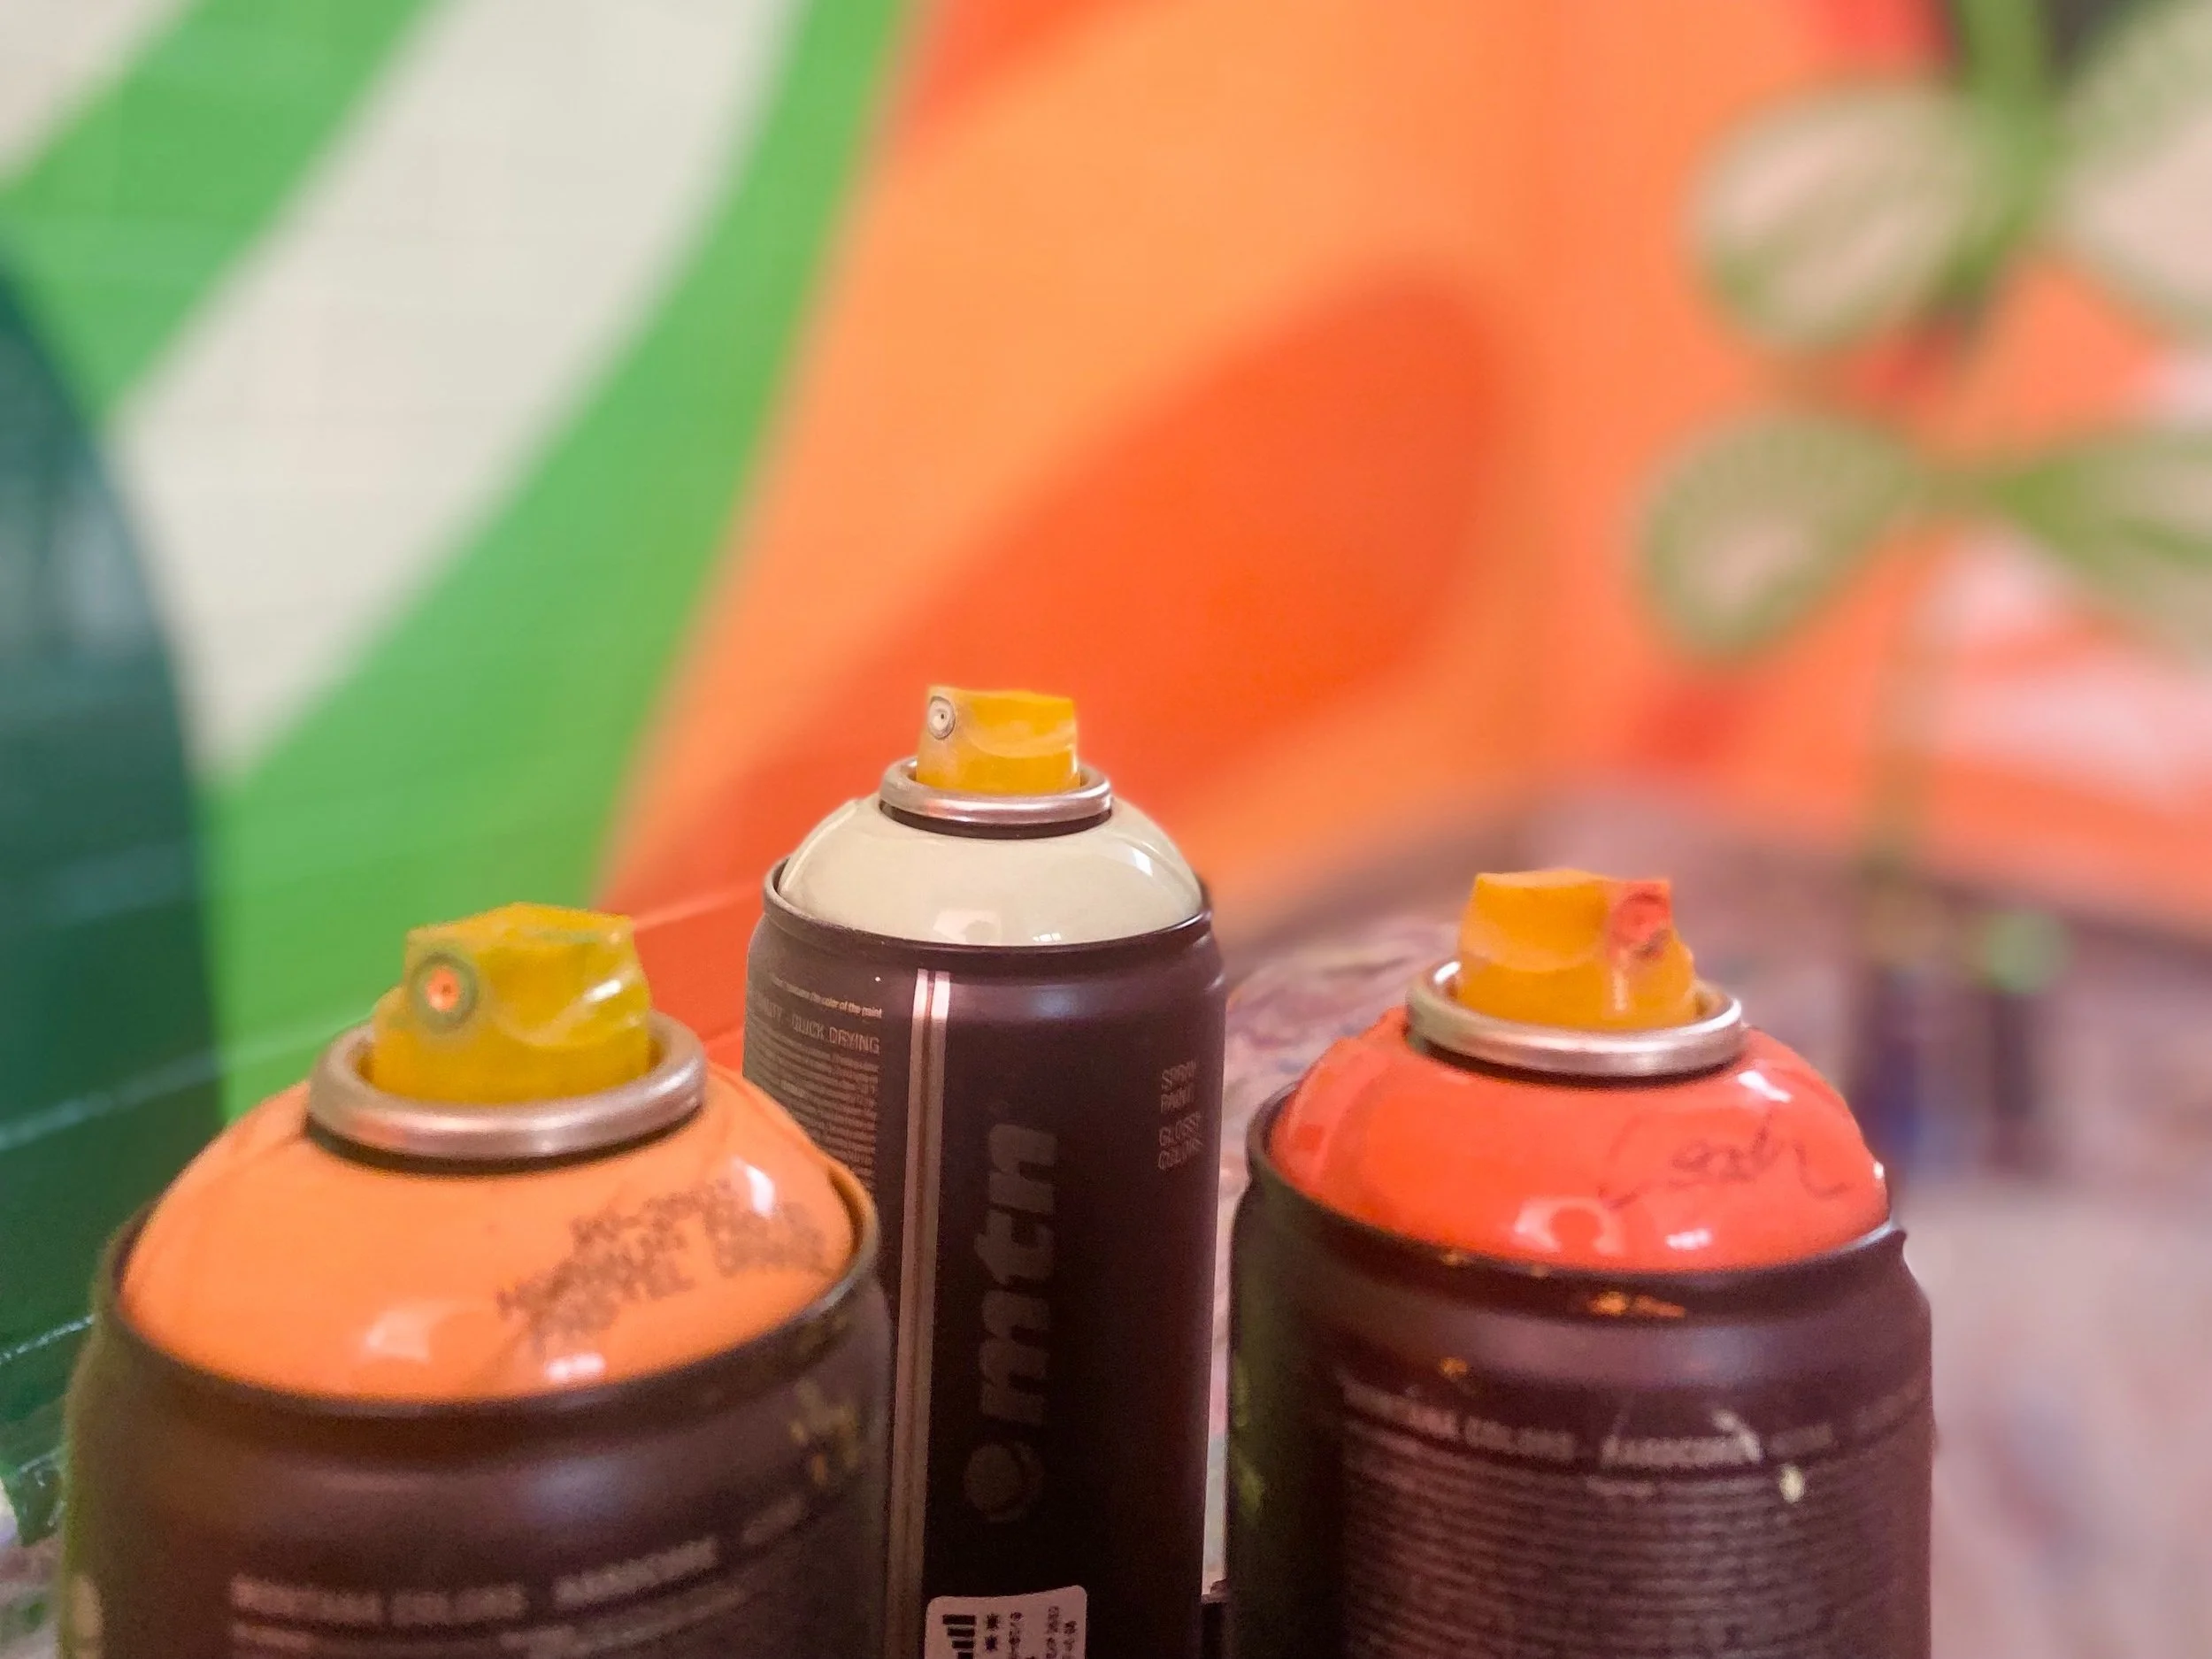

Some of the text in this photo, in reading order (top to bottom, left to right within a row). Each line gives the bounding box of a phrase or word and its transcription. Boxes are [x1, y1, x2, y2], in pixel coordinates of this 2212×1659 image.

[791, 1012, 825, 1041] QUICK
[829, 1025, 880, 1055] DRYING
[975, 1123, 1059, 1426] mtn
